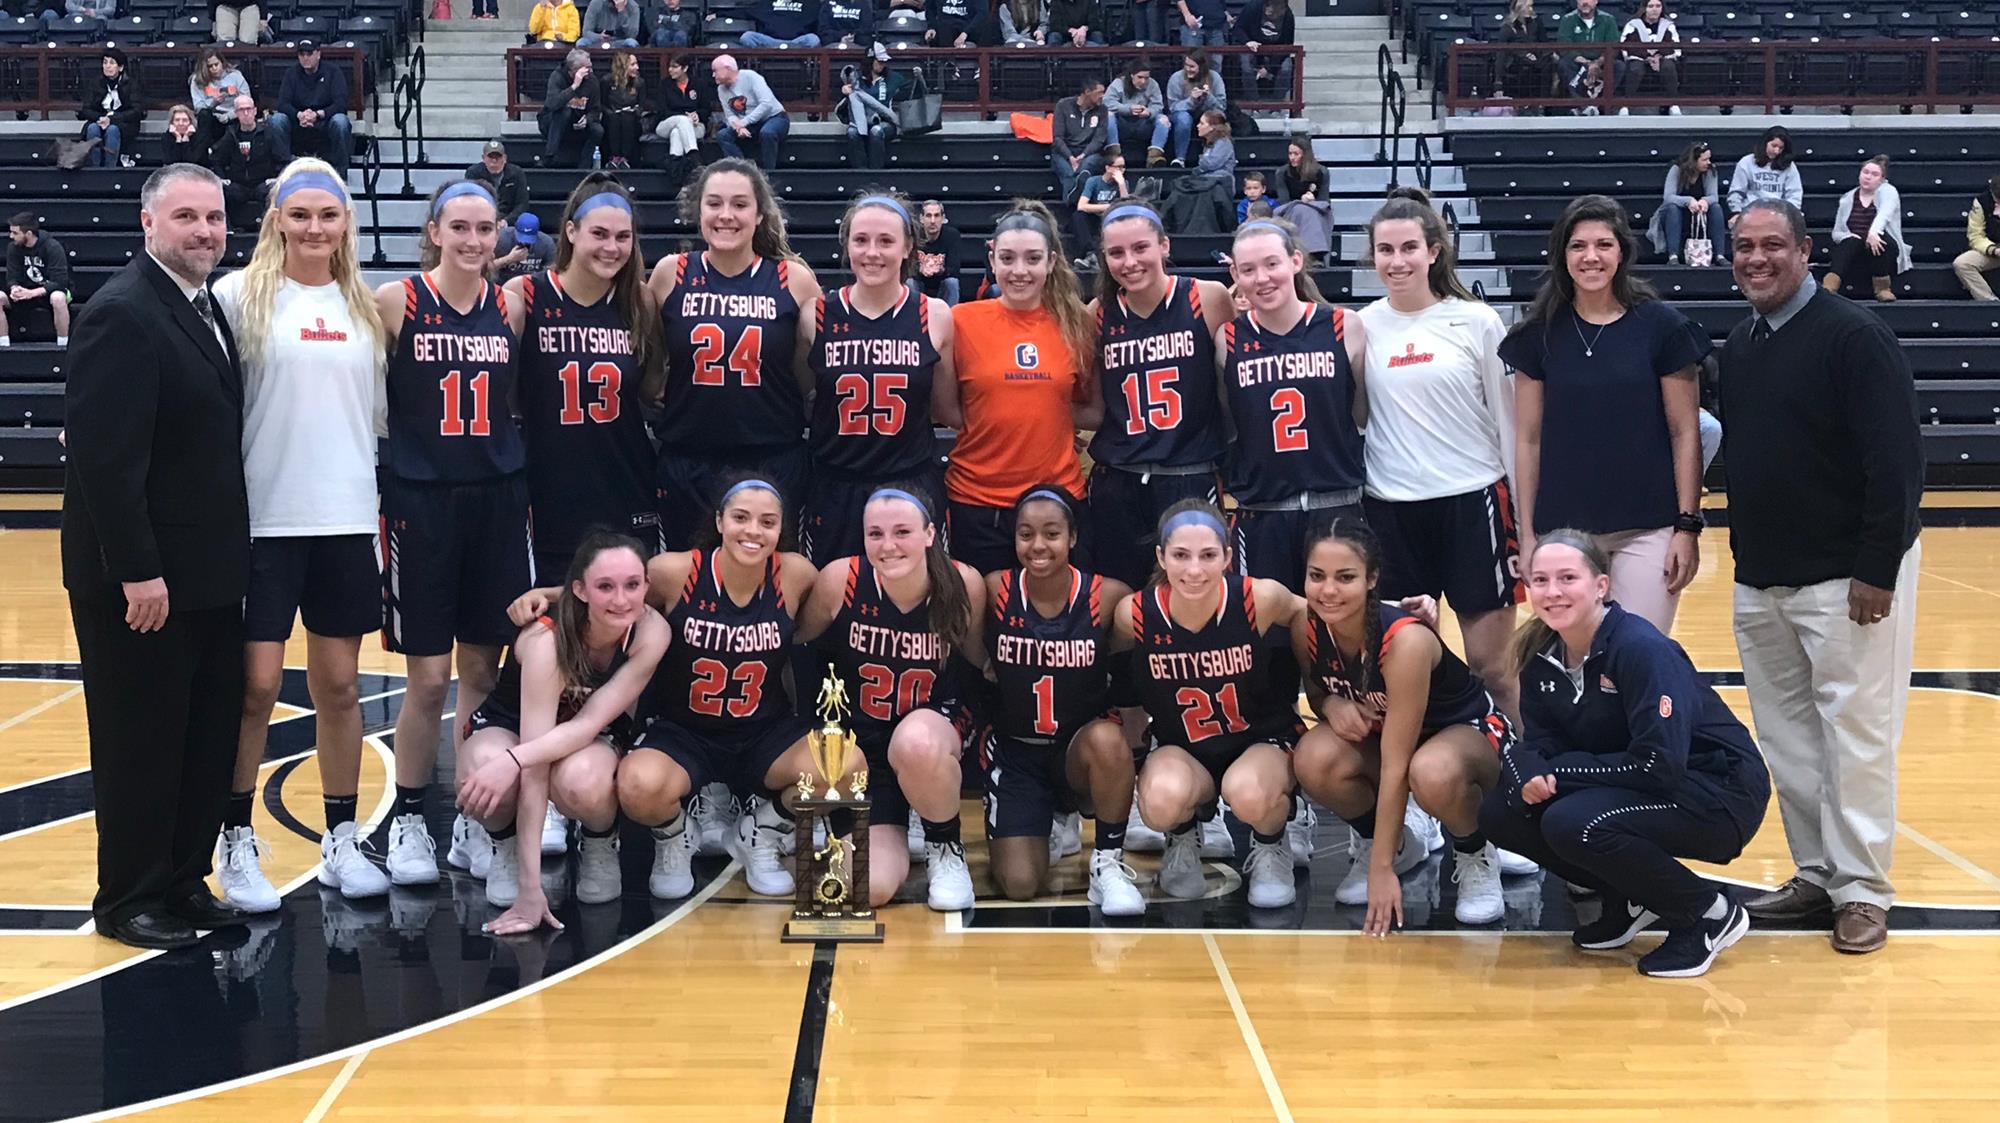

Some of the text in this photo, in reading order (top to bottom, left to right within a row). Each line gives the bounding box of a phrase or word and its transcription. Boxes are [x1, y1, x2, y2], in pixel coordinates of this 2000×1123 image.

[1754, 171, 1780, 182] WEST
[681, 292, 777, 320] GETTYSBURG
[413, 333, 509, 363] GETTYSBURG
[538, 326, 633, 355] GETTYSBURG
[690, 323, 762, 386] 24
[825, 339, 920, 368] GETTYSBURG
[1014, 342, 1039, 369] G
[1104, 330, 1195, 370] GETTYSBURG
[1004, 371, 1052, 381] BASKETBALL
[1237, 351, 1335, 388] GETTYSBURG
[440, 370, 490, 436] 11
[558, 361, 622, 425] 13
[835, 373, 908, 436] 25
[1121, 366, 1183, 436] 15
[1270, 387, 1309, 453] 2
[683, 616, 782, 653] GETTYSBURG
[849, 621, 951, 661] GETTYSBUR
[997, 633, 1095, 668] GETTYSBURG
[1149, 644, 1253, 680] GETTYSBURG
[689, 657, 768, 719] 23
[858, 662, 937, 721] 20
[1032, 675, 1059, 736] 1
[1175, 682, 1250, 743] 21
[797, 770, 868, 787] 20 18
